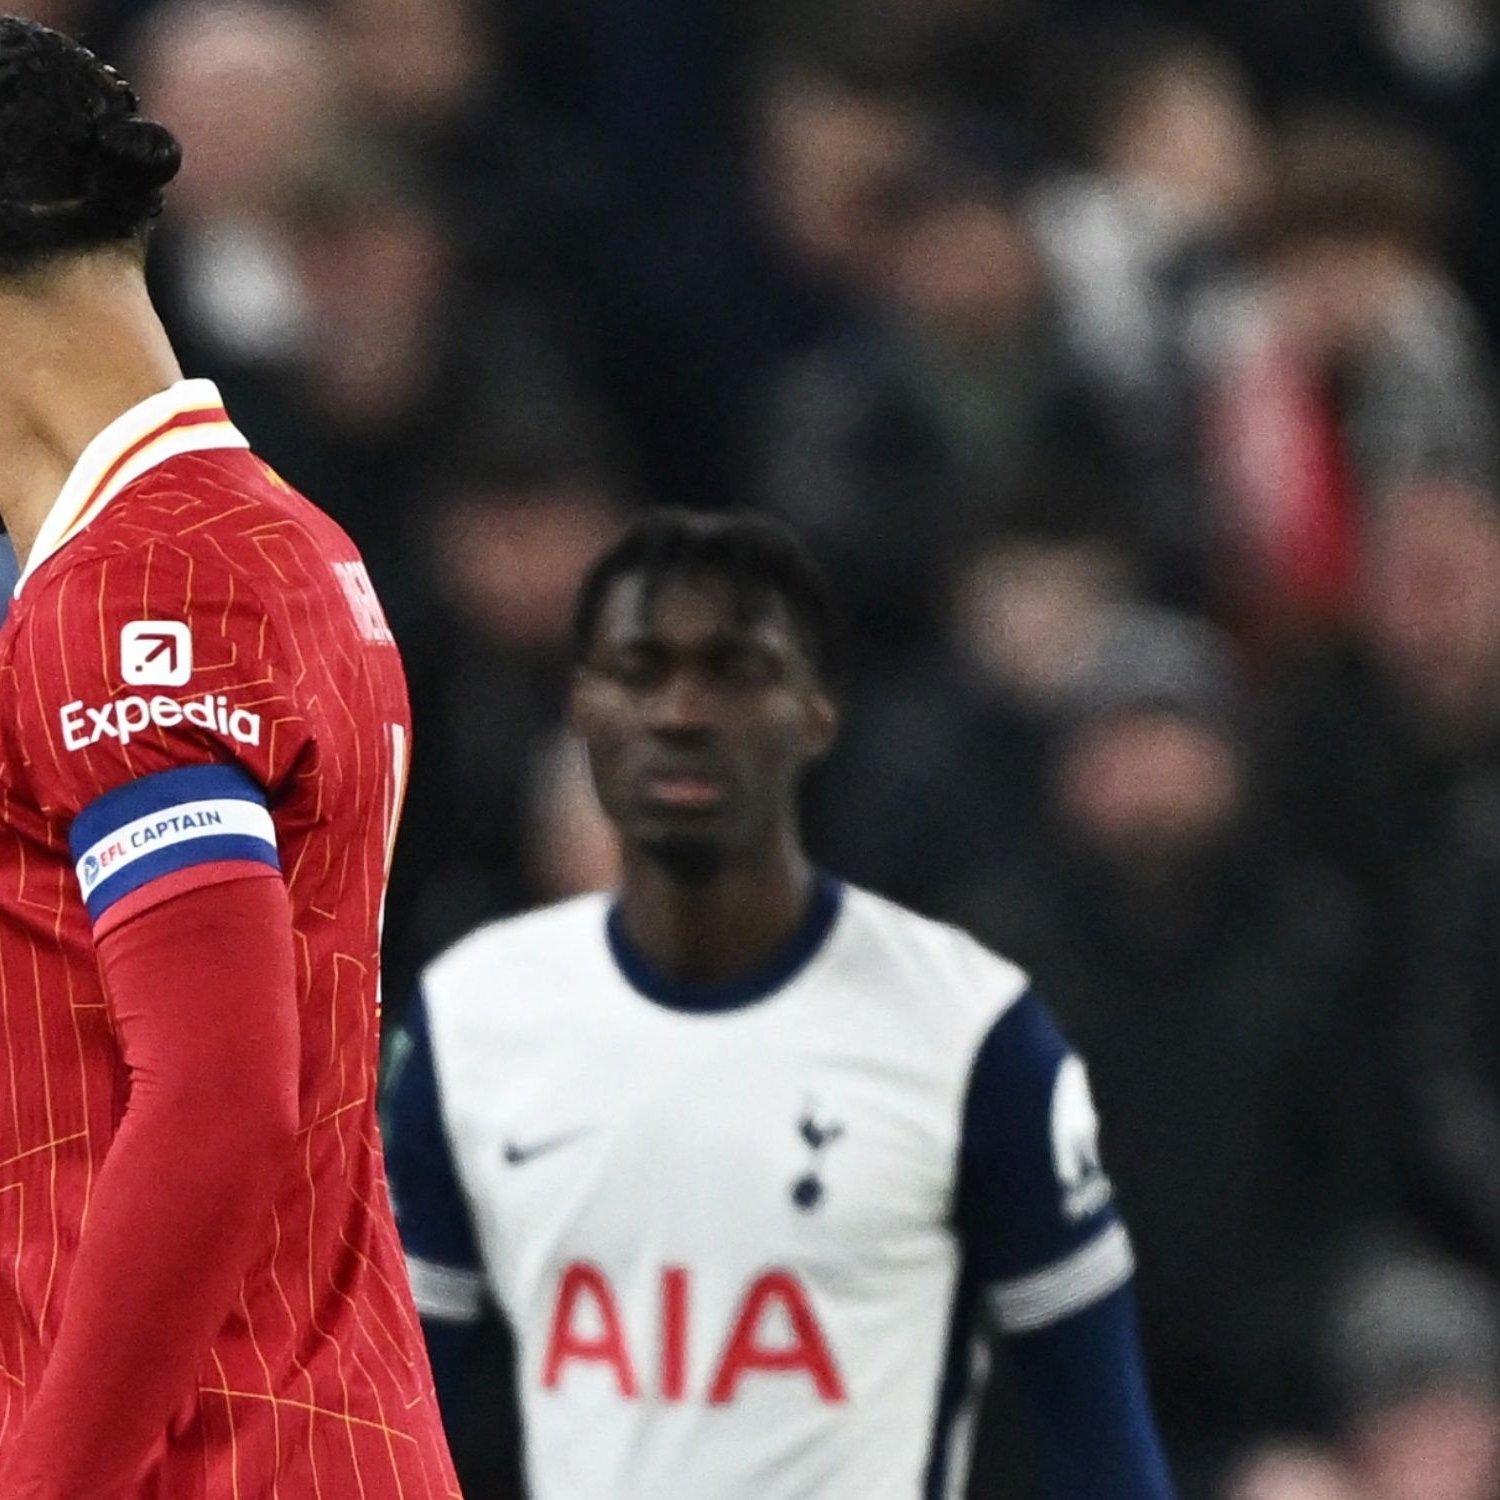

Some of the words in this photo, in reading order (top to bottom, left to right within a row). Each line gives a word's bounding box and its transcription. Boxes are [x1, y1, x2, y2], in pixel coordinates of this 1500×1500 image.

[60, 695, 260, 751] Expedia
[100, 842, 127, 867] EFL
[131, 811, 222, 848] CAPTAIN
[542, 1262, 847, 1404] AIA
